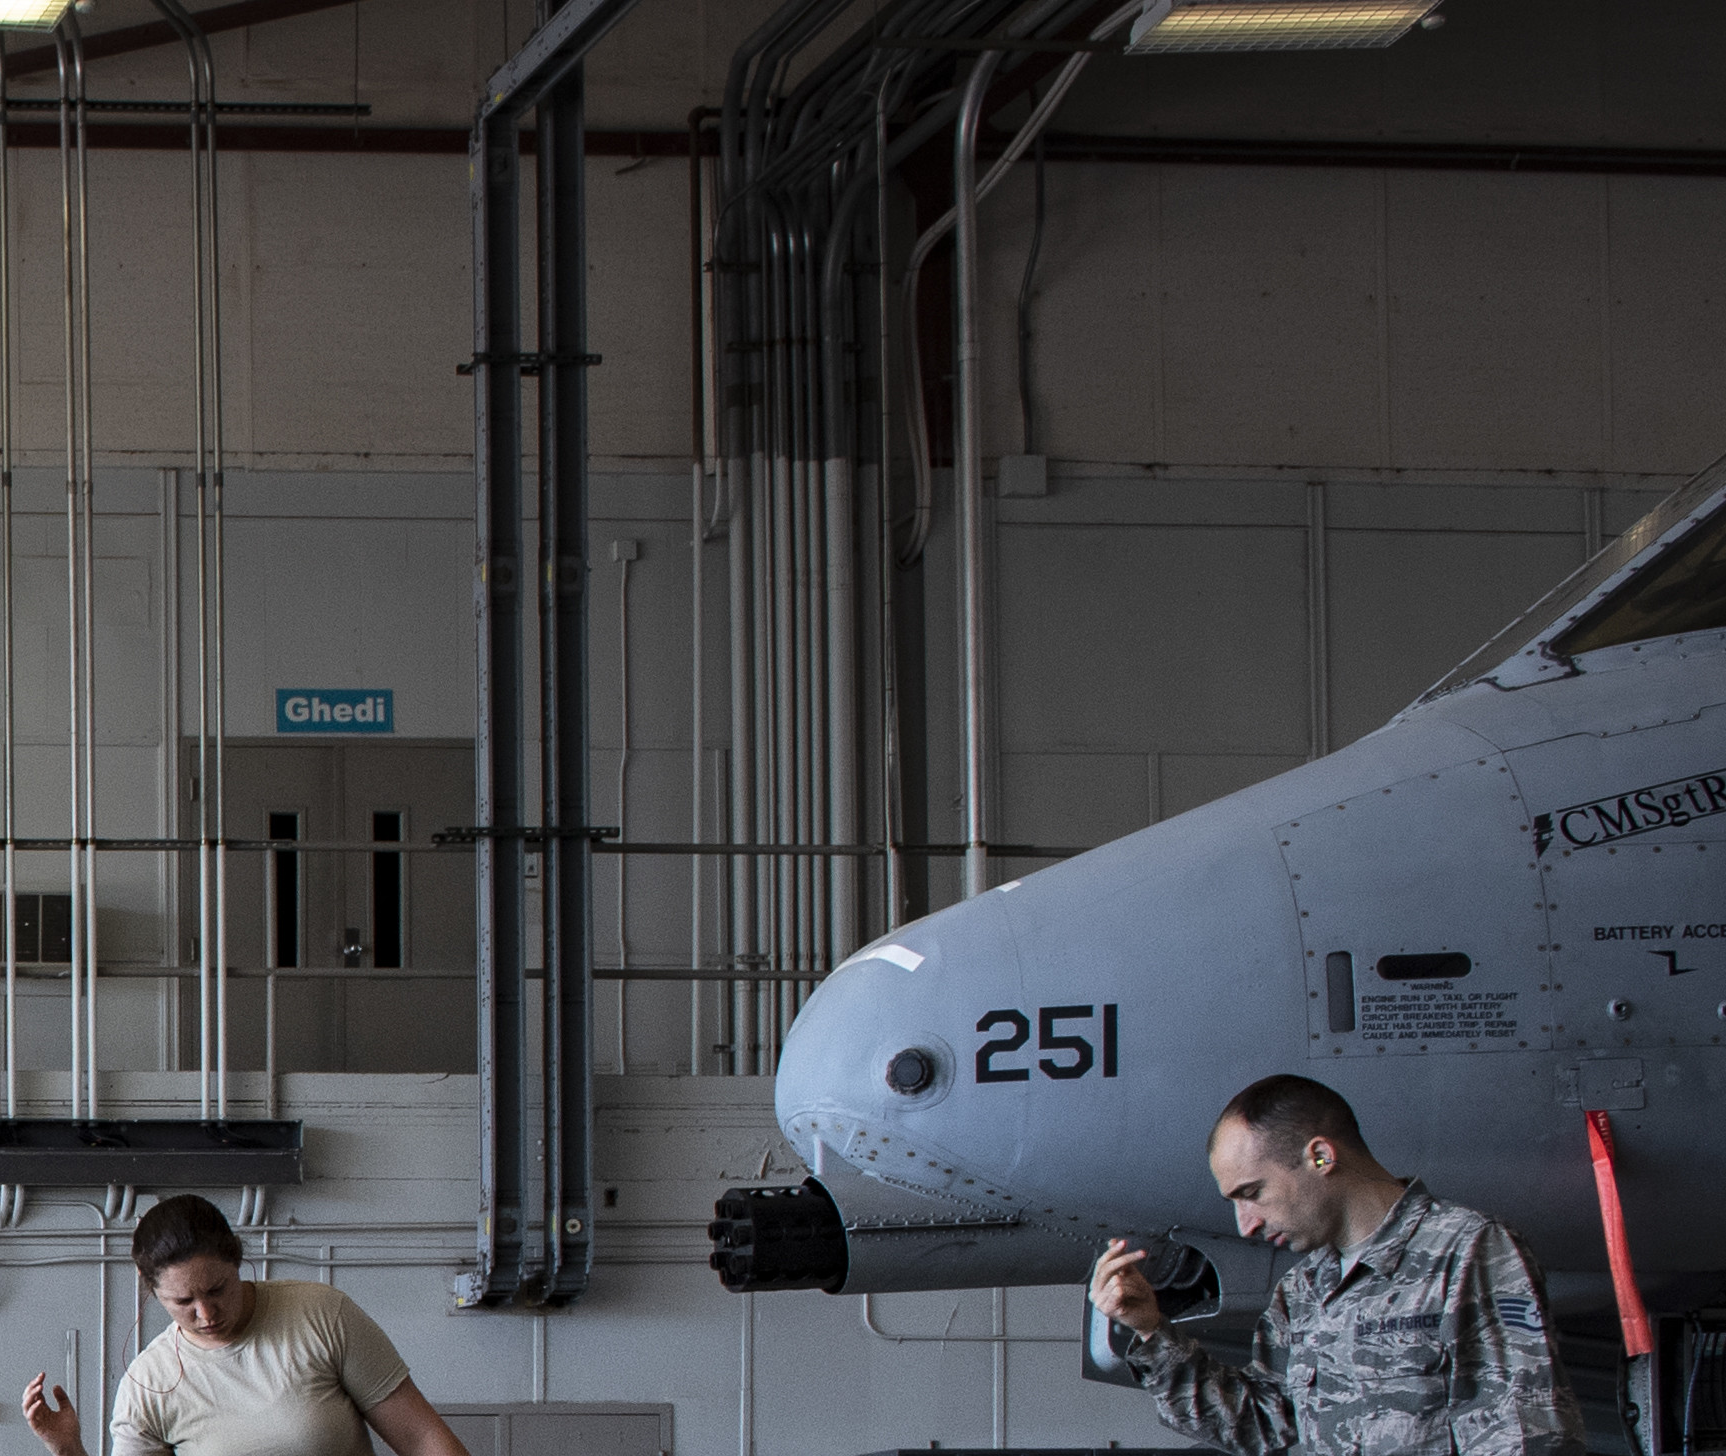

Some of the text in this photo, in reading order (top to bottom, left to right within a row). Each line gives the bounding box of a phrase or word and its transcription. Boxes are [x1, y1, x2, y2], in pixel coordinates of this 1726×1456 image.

[285, 697, 385, 722] Ghedi
[1594, 925, 1674, 941] BATTERY
[1410, 982, 1454, 991] WARNING
[1361, 995, 1397, 1003] ENGINE
[1400, 994, 1421, 1002] RUN
[1468, 993, 1482, 1001] OR
[1486, 992, 1518, 1001] FLIGHT
[1361, 1002, 1501, 1013] IS PROHIBITED WITH BATTERY
[1362, 1011, 1504, 1022] CIRCUIT BREAKERS PULLED IF
[1362, 1023, 1389, 1031] FAULT
[1393, 1022, 1412, 1030] HAS
[1416, 1021, 1455, 1030] CAUSED
[1484, 1020, 1517, 1029] REPAIR
[1362, 1029, 1516, 1040] CAUSE AND IMMEDIATELY RESET
[976, 1003, 1118, 1084] 251
[1379, 1317, 1396, 1333] AIR
[1399, 1313, 1441, 1331] FORCE
